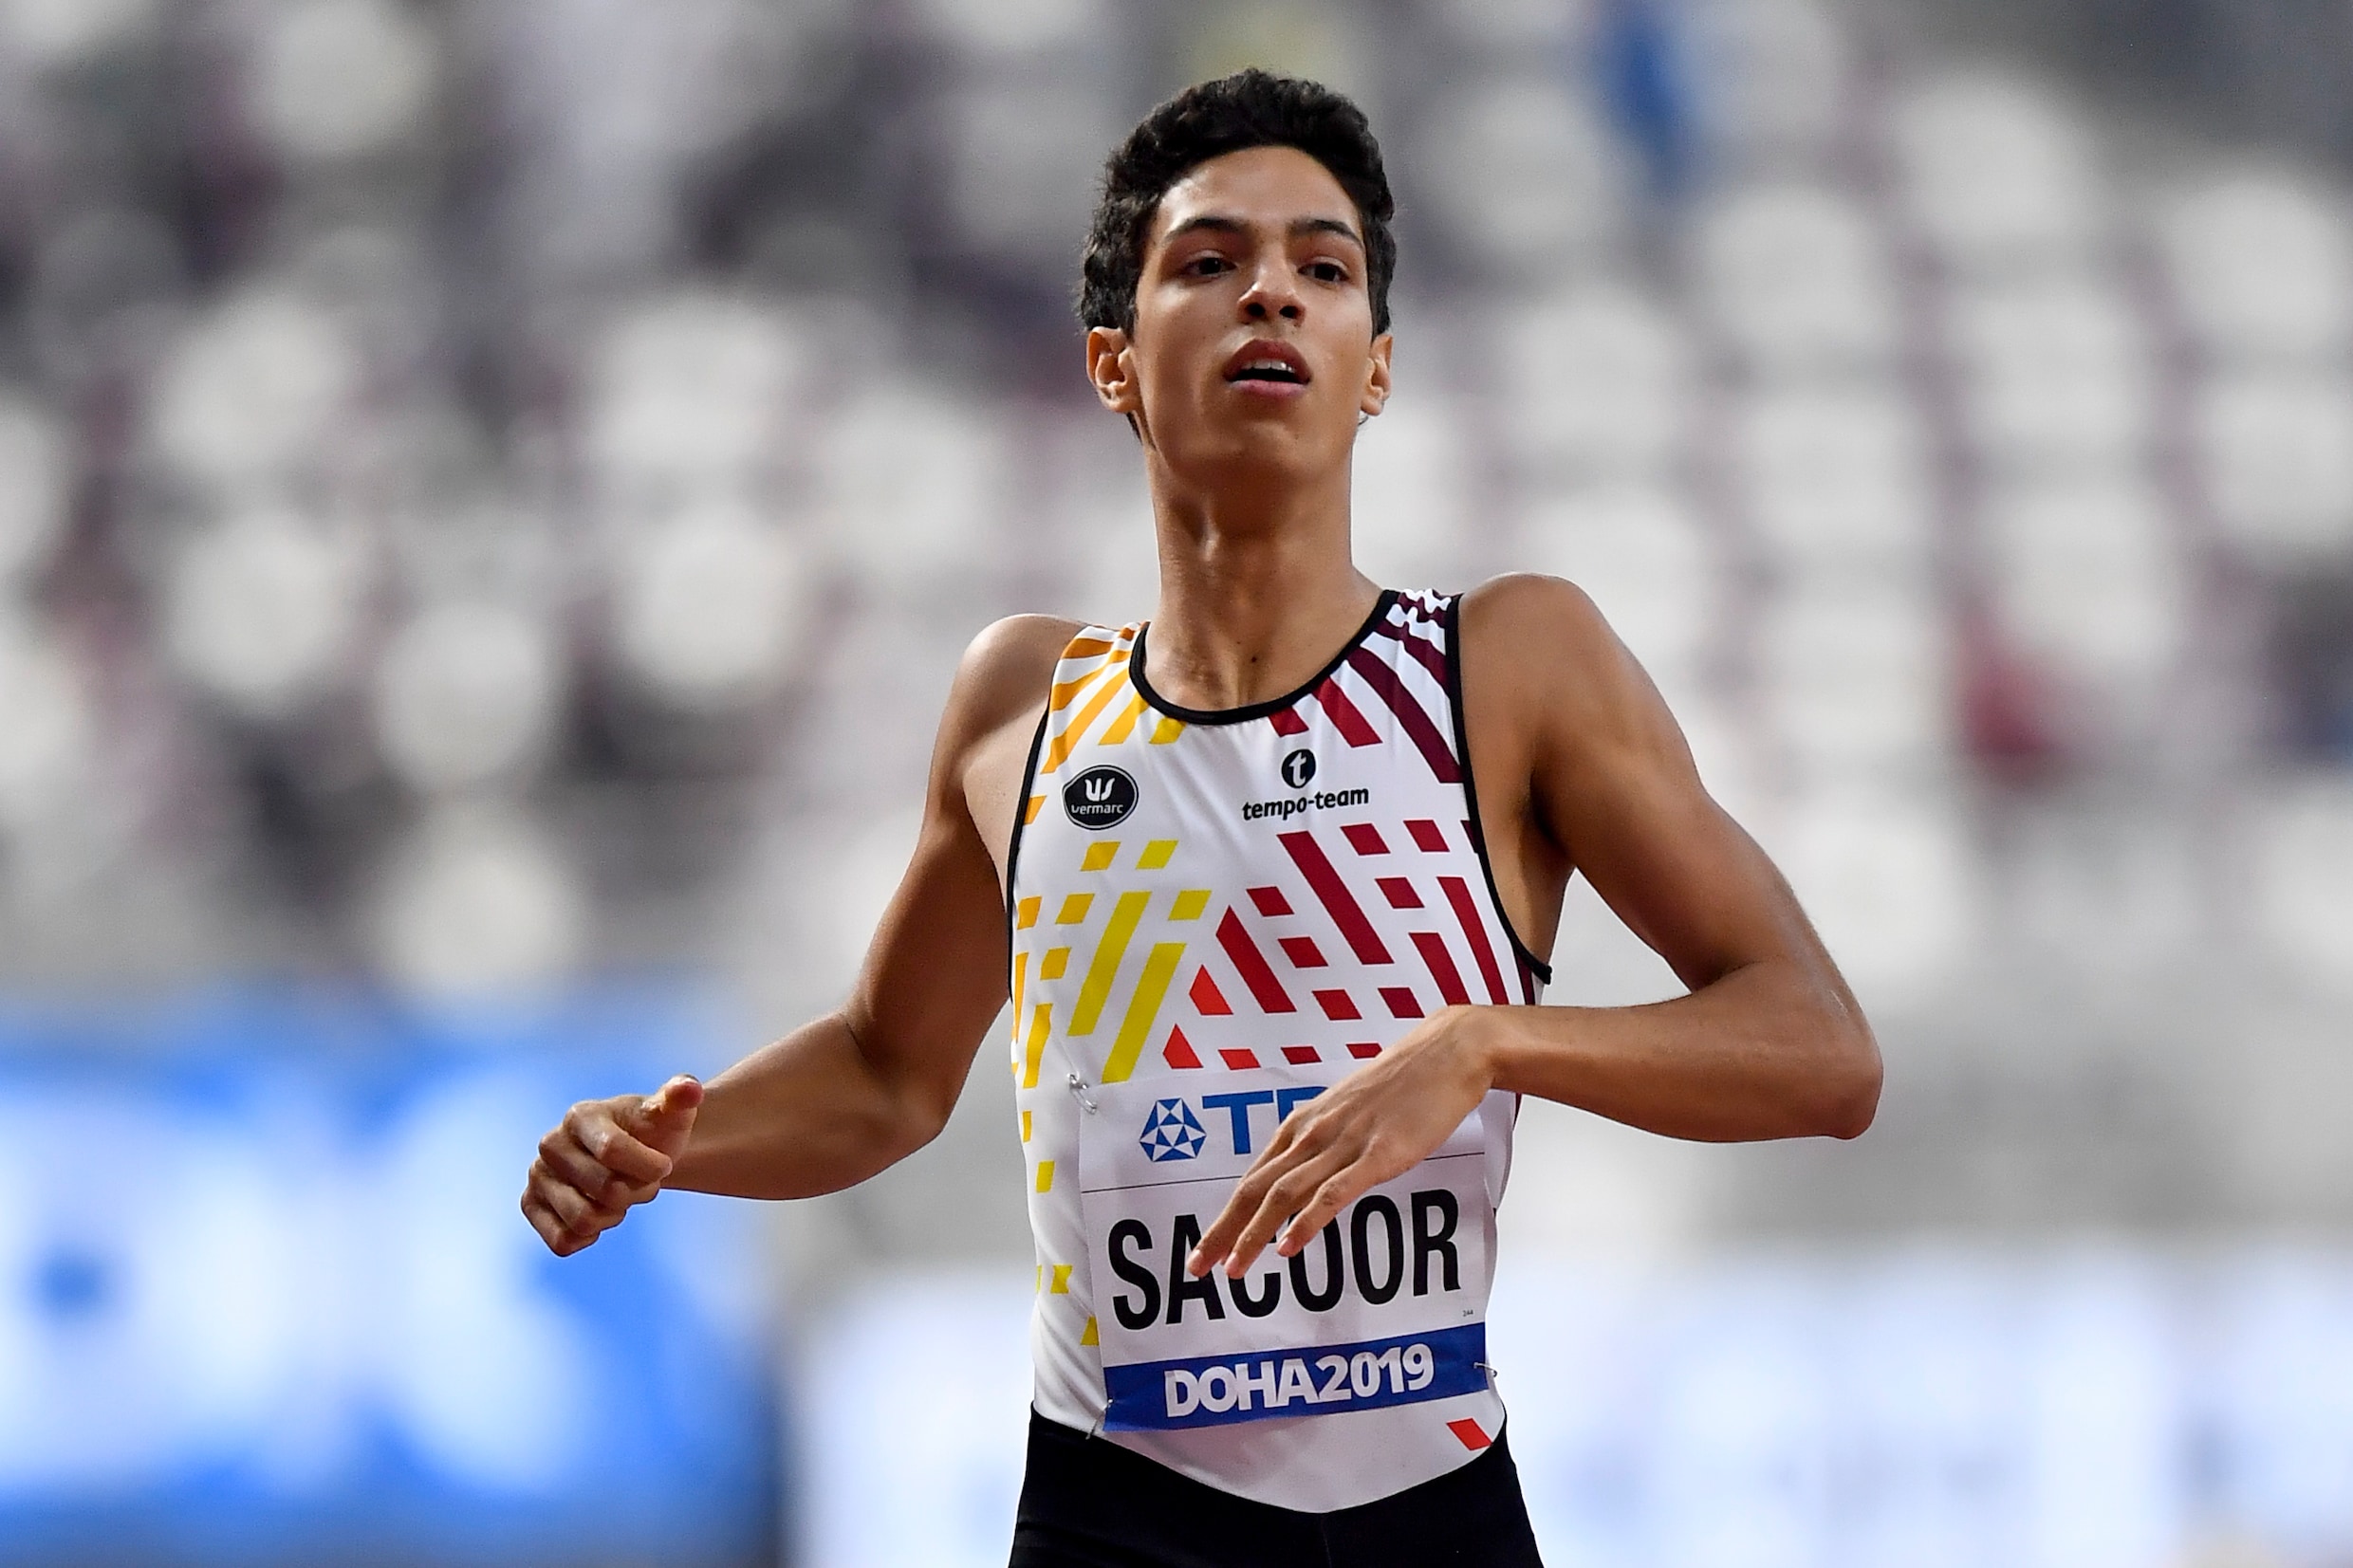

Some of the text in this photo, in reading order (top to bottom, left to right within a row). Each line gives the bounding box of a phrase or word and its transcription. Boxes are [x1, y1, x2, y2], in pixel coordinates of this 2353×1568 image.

[1288, 751, 1307, 786] t
[1070, 804, 1124, 815] vermarc
[1242, 788, 1369, 821] tempo-team
[1164, 1343, 1435, 1418] DOHA2019
